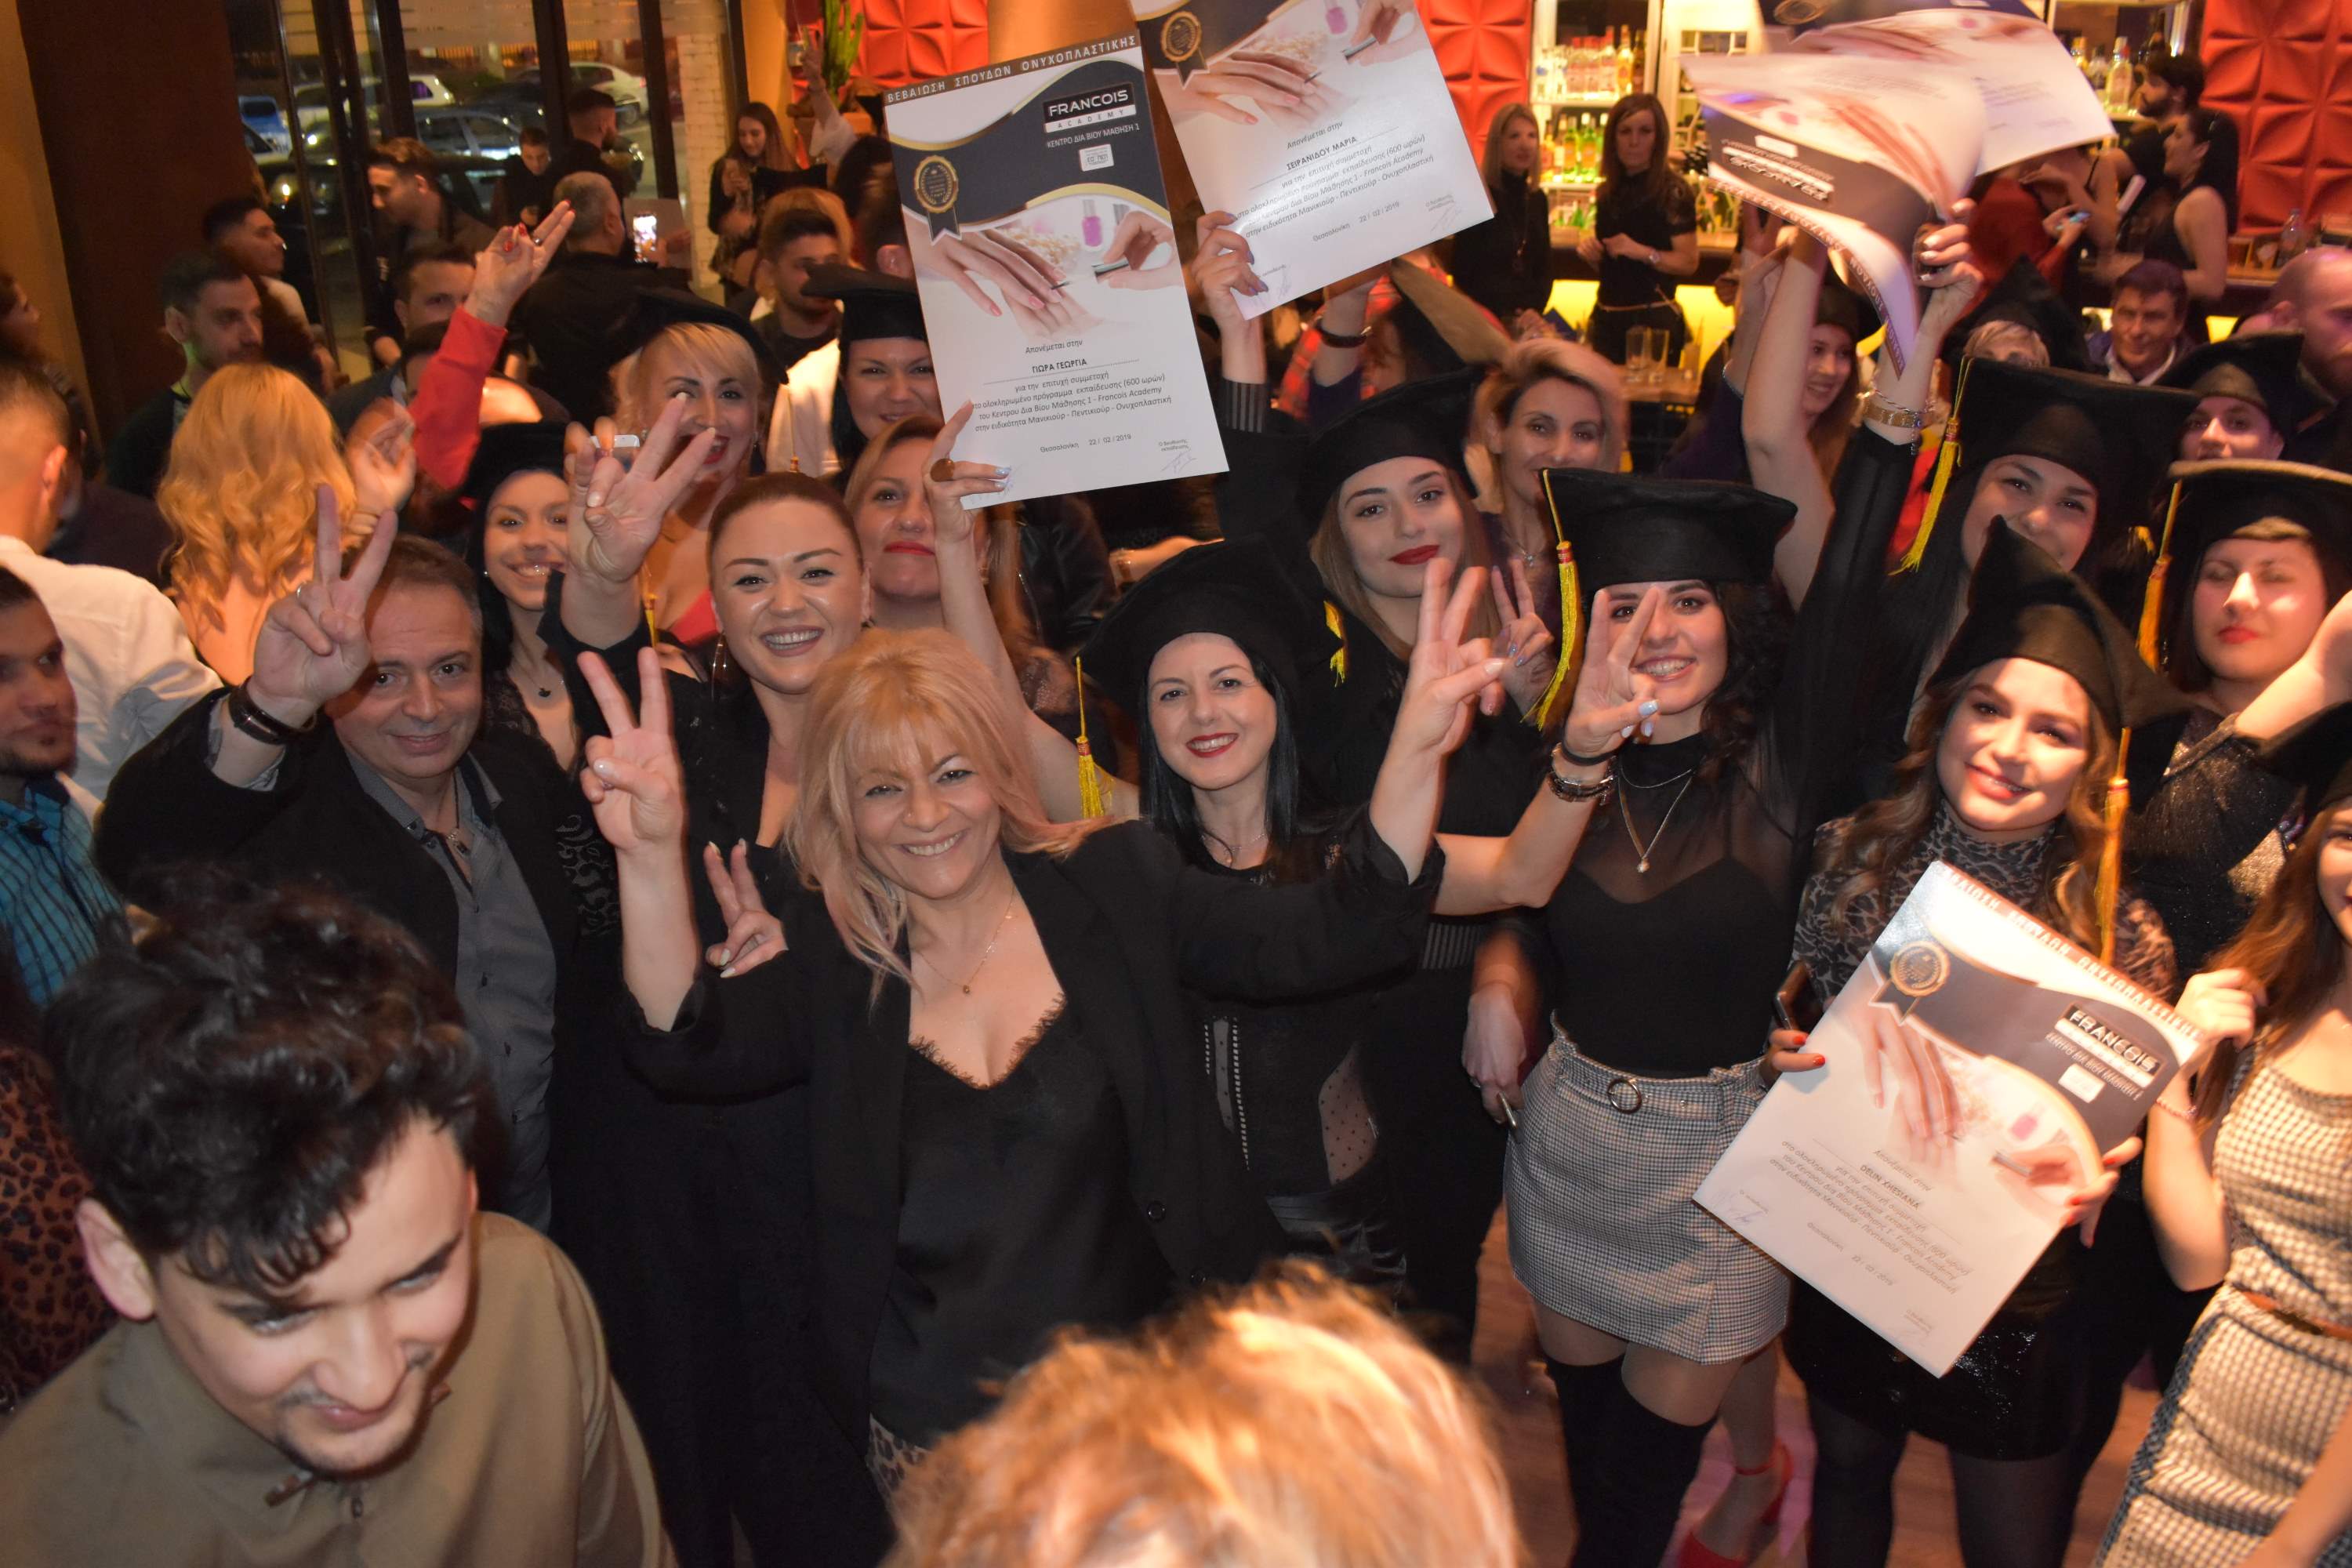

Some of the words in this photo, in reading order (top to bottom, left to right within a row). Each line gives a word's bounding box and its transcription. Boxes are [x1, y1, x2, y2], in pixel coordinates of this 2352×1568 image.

[887, 82, 945, 102] ΒΕΒΑΙΩΣΗ
[954, 65, 1011, 86] ΣΠΟΥΔΩΝ
[1022, 35, 1136, 71] ΟΝΥΧΟΠΛΑΣΤΙΚΗΣ
[1048, 90, 1128, 115] FRANCOIS
[1057, 109, 1123, 128] ACADEMY
[1047, 136, 1073, 148] ΚΕΝΤΡΟ
[1073, 133, 1085, 143] ΔΙΑ
[1086, 129, 1102, 140] ΒΙΟΥ
[1333, 136, 1356, 151] ΜΑΡΙΑ
[1025, 340, 1065, 354] Απονέμεται
[1065, 339, 1083, 348] στην
[1056, 358, 1087, 369] ΓΕΩΡΓΙΑ
[1041, 377, 1069, 389] επιτυχή
[1069, 370, 1109, 385] συμμετοχή
[982, 394, 1032, 409] ολοκληρωμένο
[1033, 387, 1073, 401] πρόγραμμα
[1123, 377, 1140, 387] (600
[1128, 385, 1162, 398] Academy
[975, 424, 989, 433] στην
[2069, 1009, 2158, 1072] FRANCOIS
